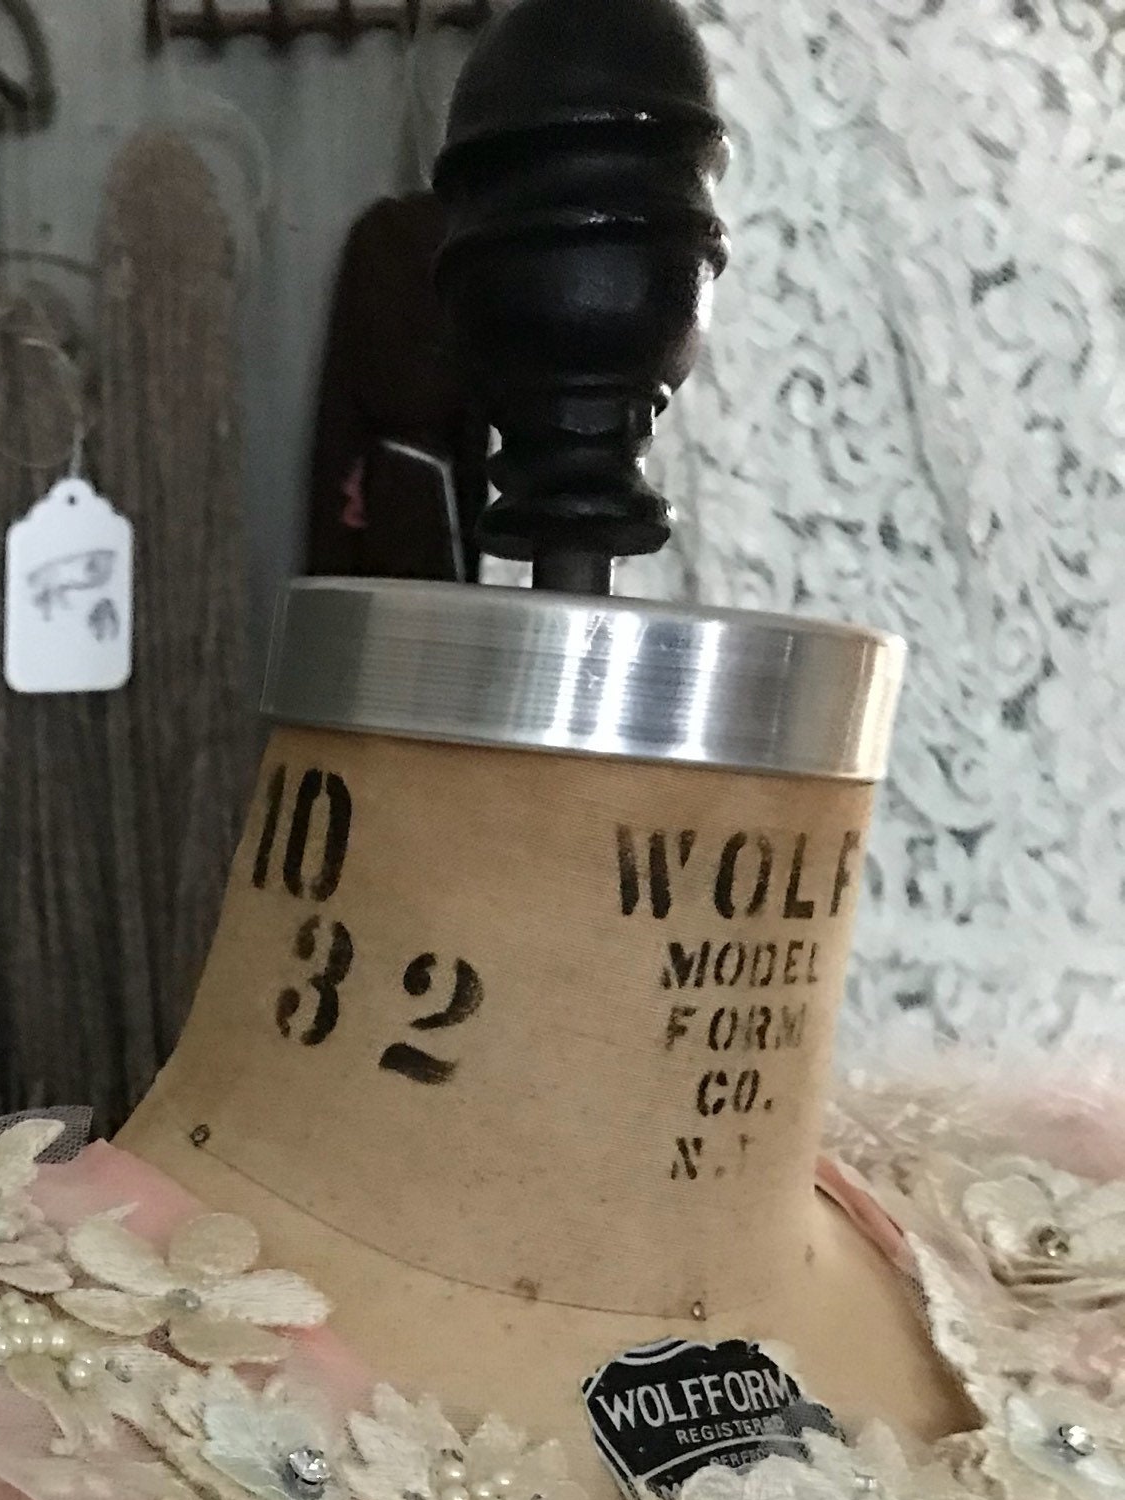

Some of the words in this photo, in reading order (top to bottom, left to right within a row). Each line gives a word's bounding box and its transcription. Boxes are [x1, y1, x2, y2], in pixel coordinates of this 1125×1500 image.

[251, 766, 352, 901] 10
[616, 825, 861, 920] WOLF
[660, 940, 818, 990] MODEL
[664, 1003, 807, 1051] FORM
[696, 1069, 773, 1116] CO.
[596, 1368, 791, 1432] WOLFFORM
